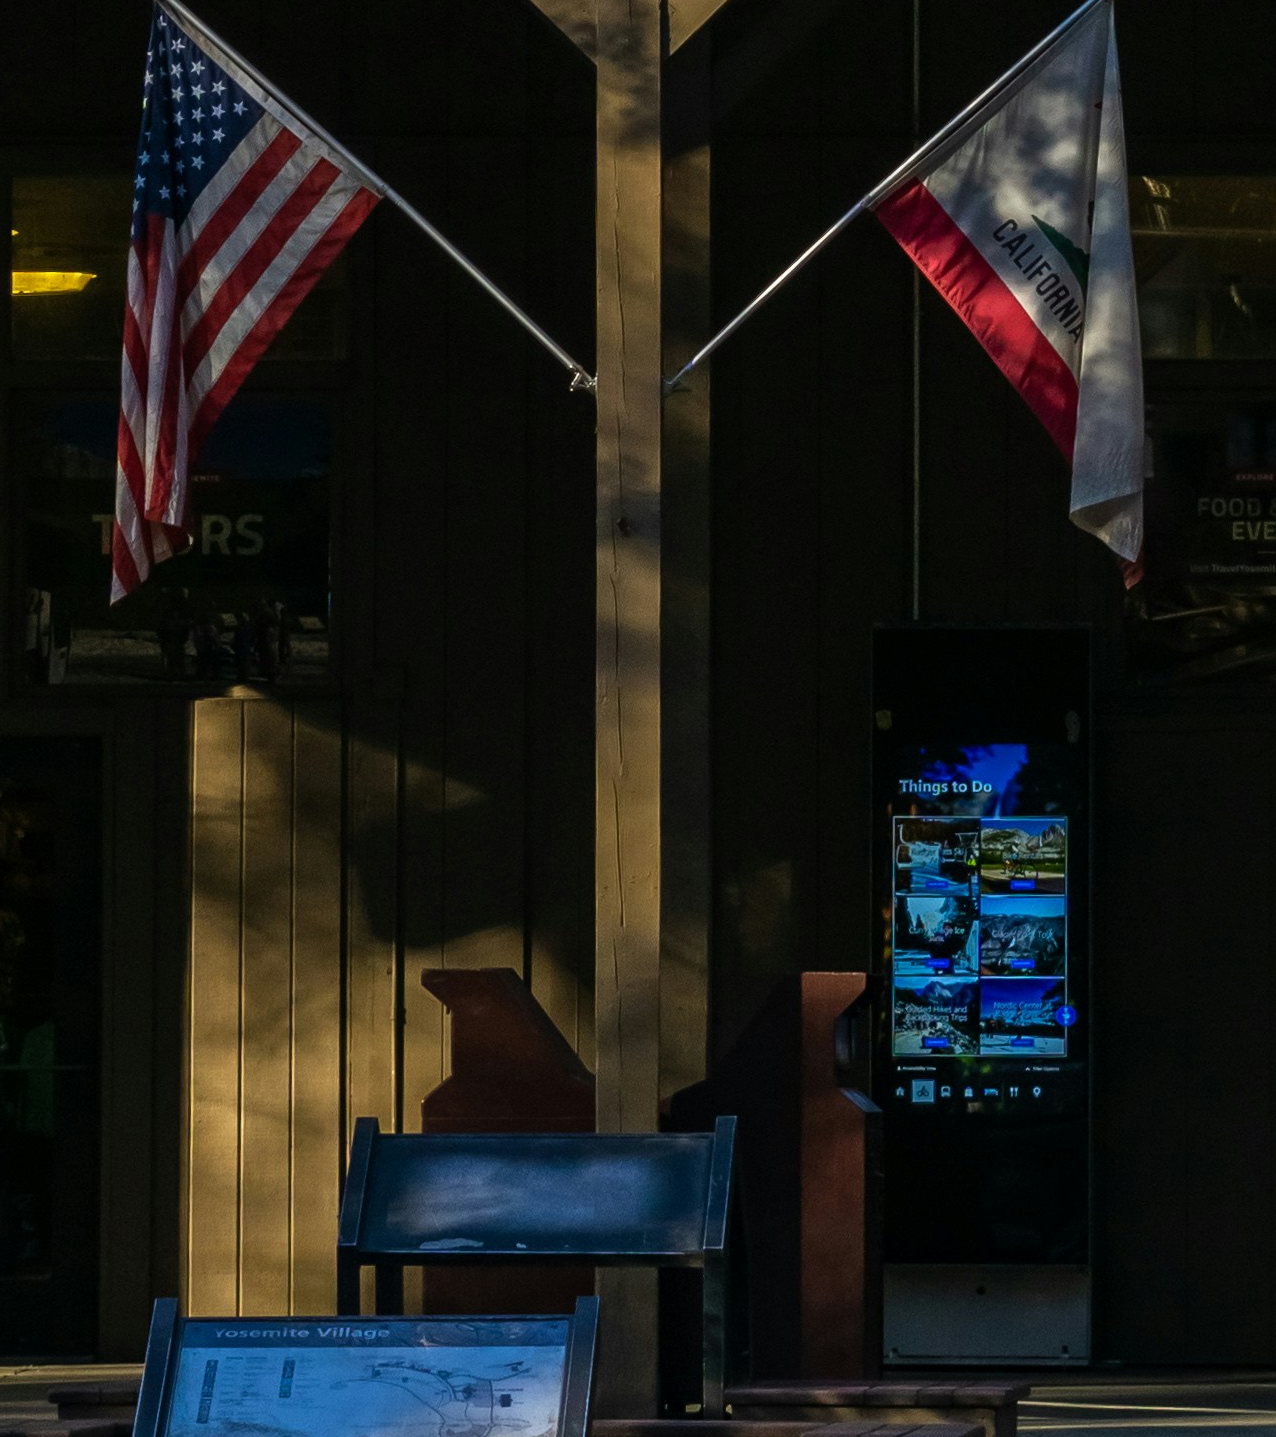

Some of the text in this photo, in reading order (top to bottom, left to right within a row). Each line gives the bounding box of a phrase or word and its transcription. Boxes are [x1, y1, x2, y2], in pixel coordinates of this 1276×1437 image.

[992, 218, 1085, 344] CALIFORNIA
[1235, 473, 1274, 481] EXPLORE
[1196, 497, 1262, 517] FOOD
[91, 513, 265, 556] TRS
[898, 779, 993, 797] Things to Do
[215, 1326, 391, 1341] Yosemite Village
